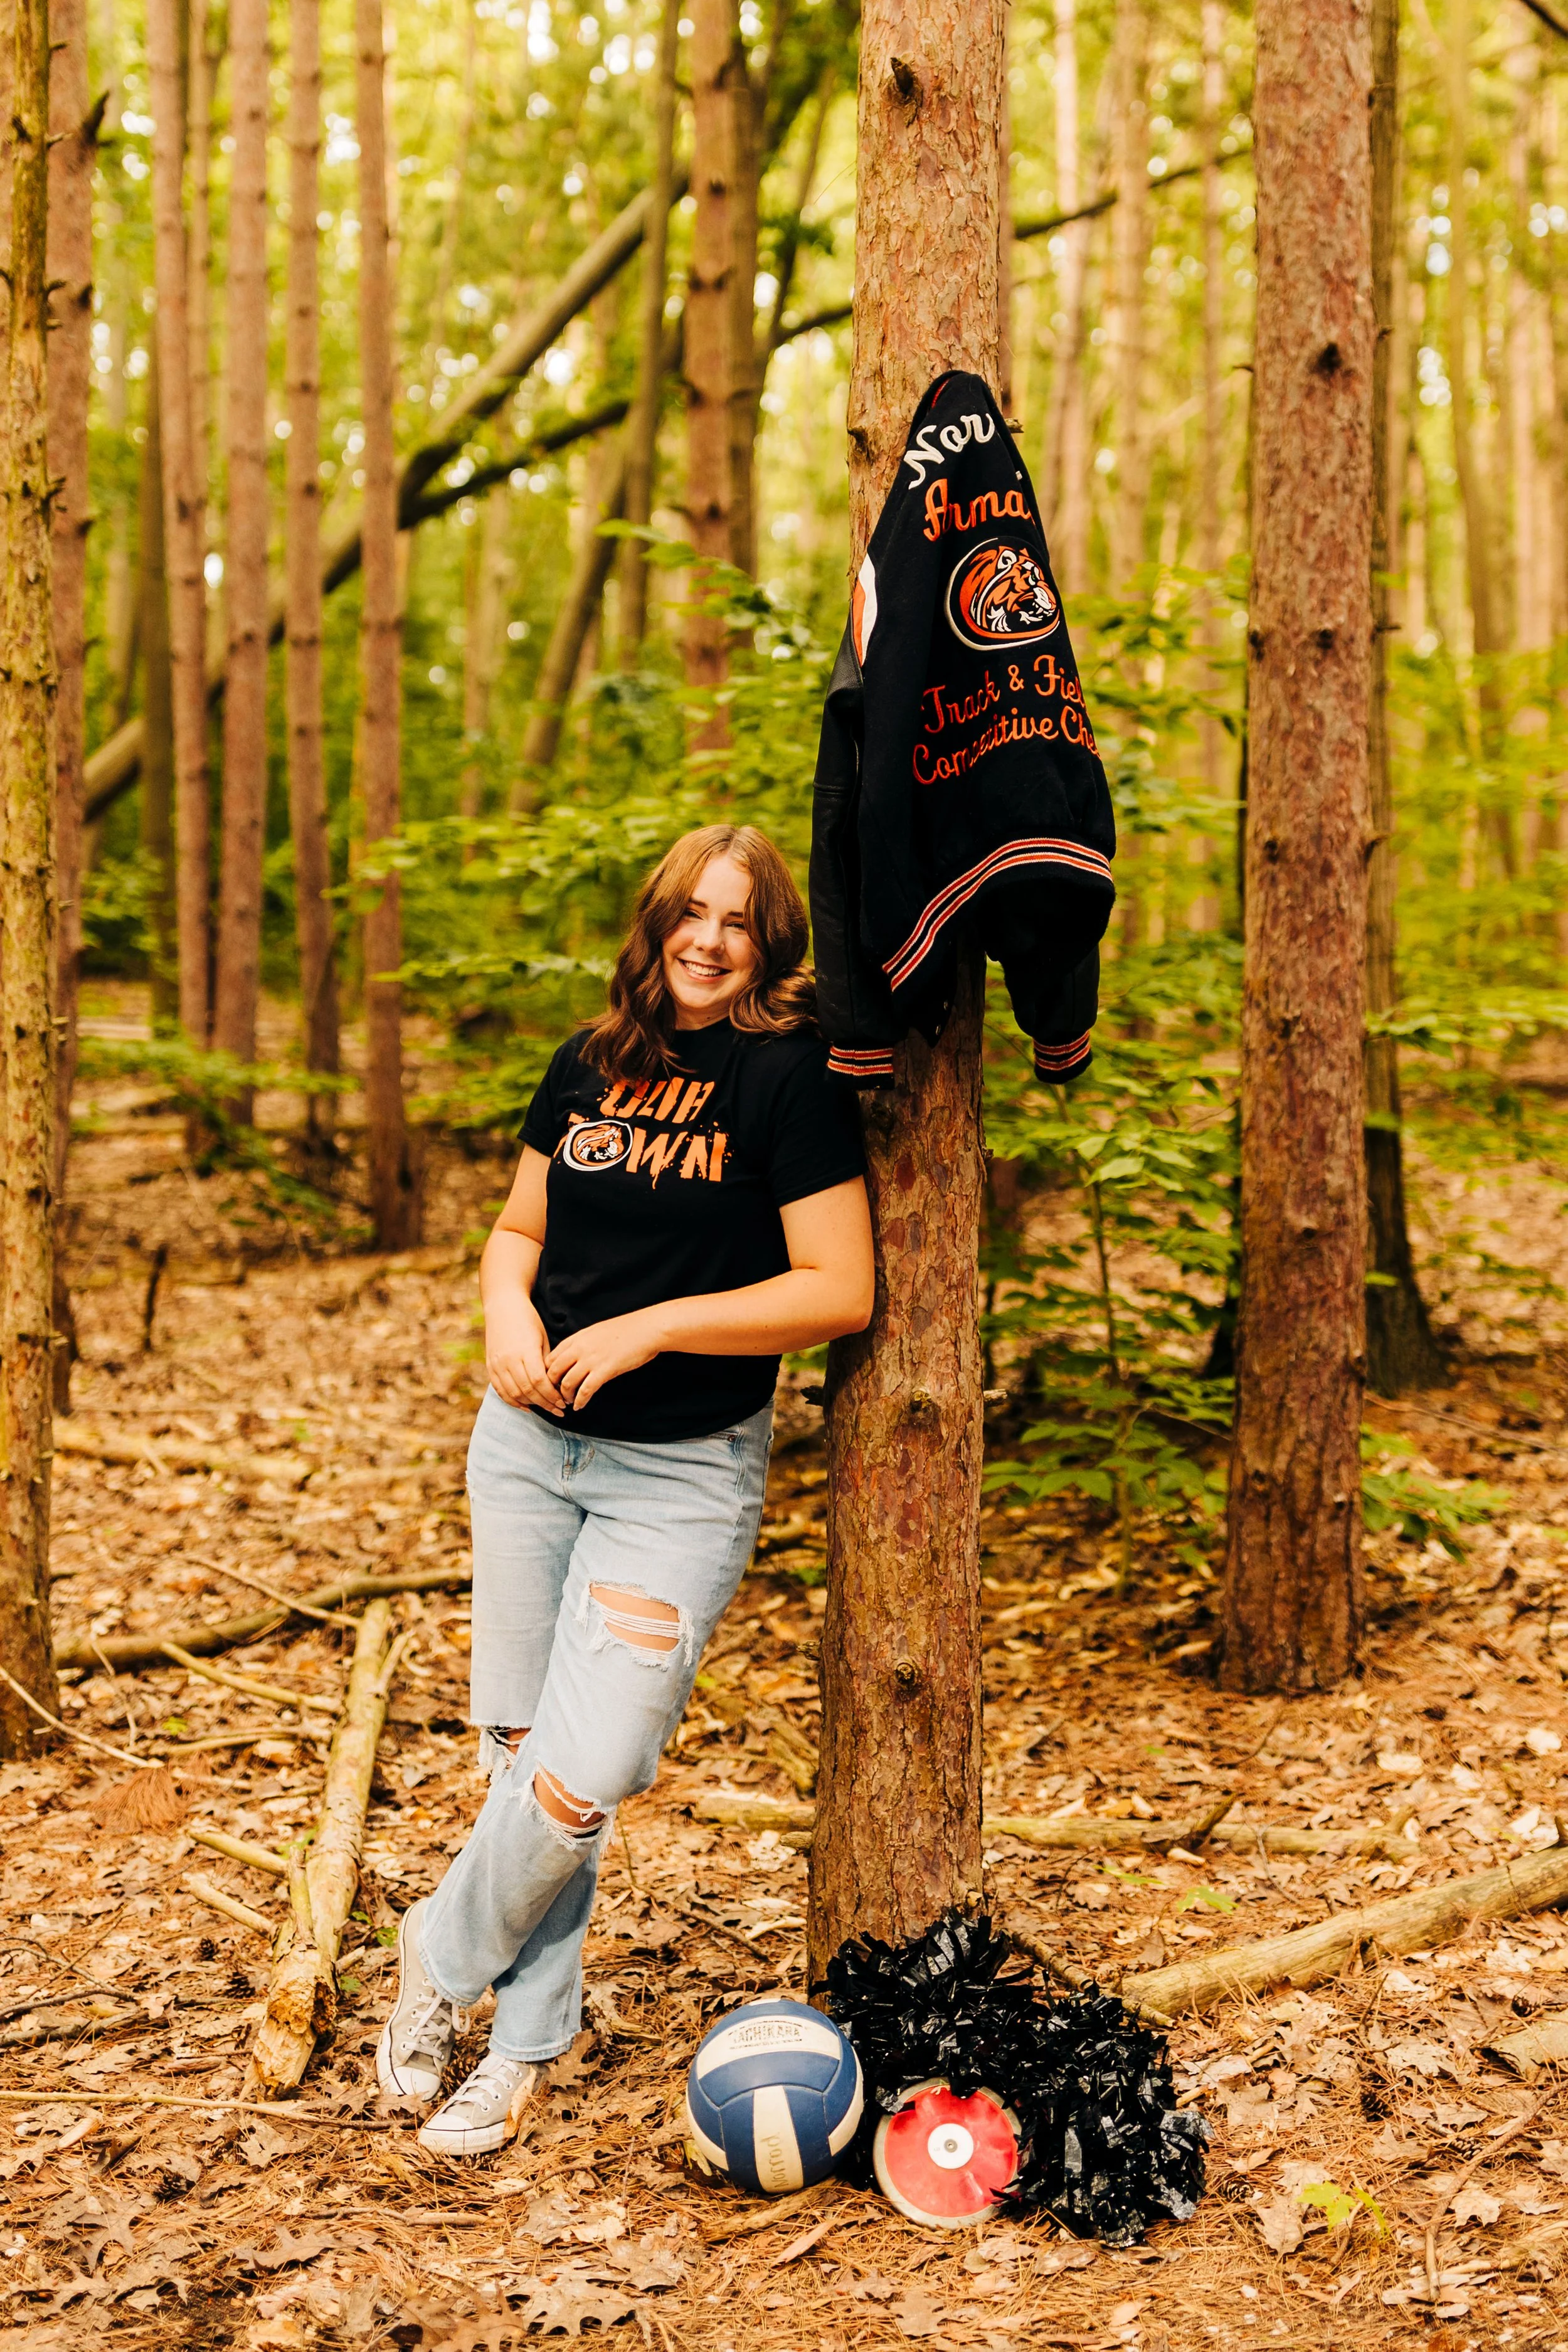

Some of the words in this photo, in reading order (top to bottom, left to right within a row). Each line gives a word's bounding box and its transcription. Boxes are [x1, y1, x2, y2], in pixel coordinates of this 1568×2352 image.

[903, 413, 997, 490] Nor
[923, 478, 1034, 542] Arma
[920, 670, 1000, 734] Track
[1007, 664, 1025, 691] &
[1033, 654, 1086, 708] Fiel
[1060, 705, 1101, 760] Che
[760, 2134, 790, 2188] Norrod
